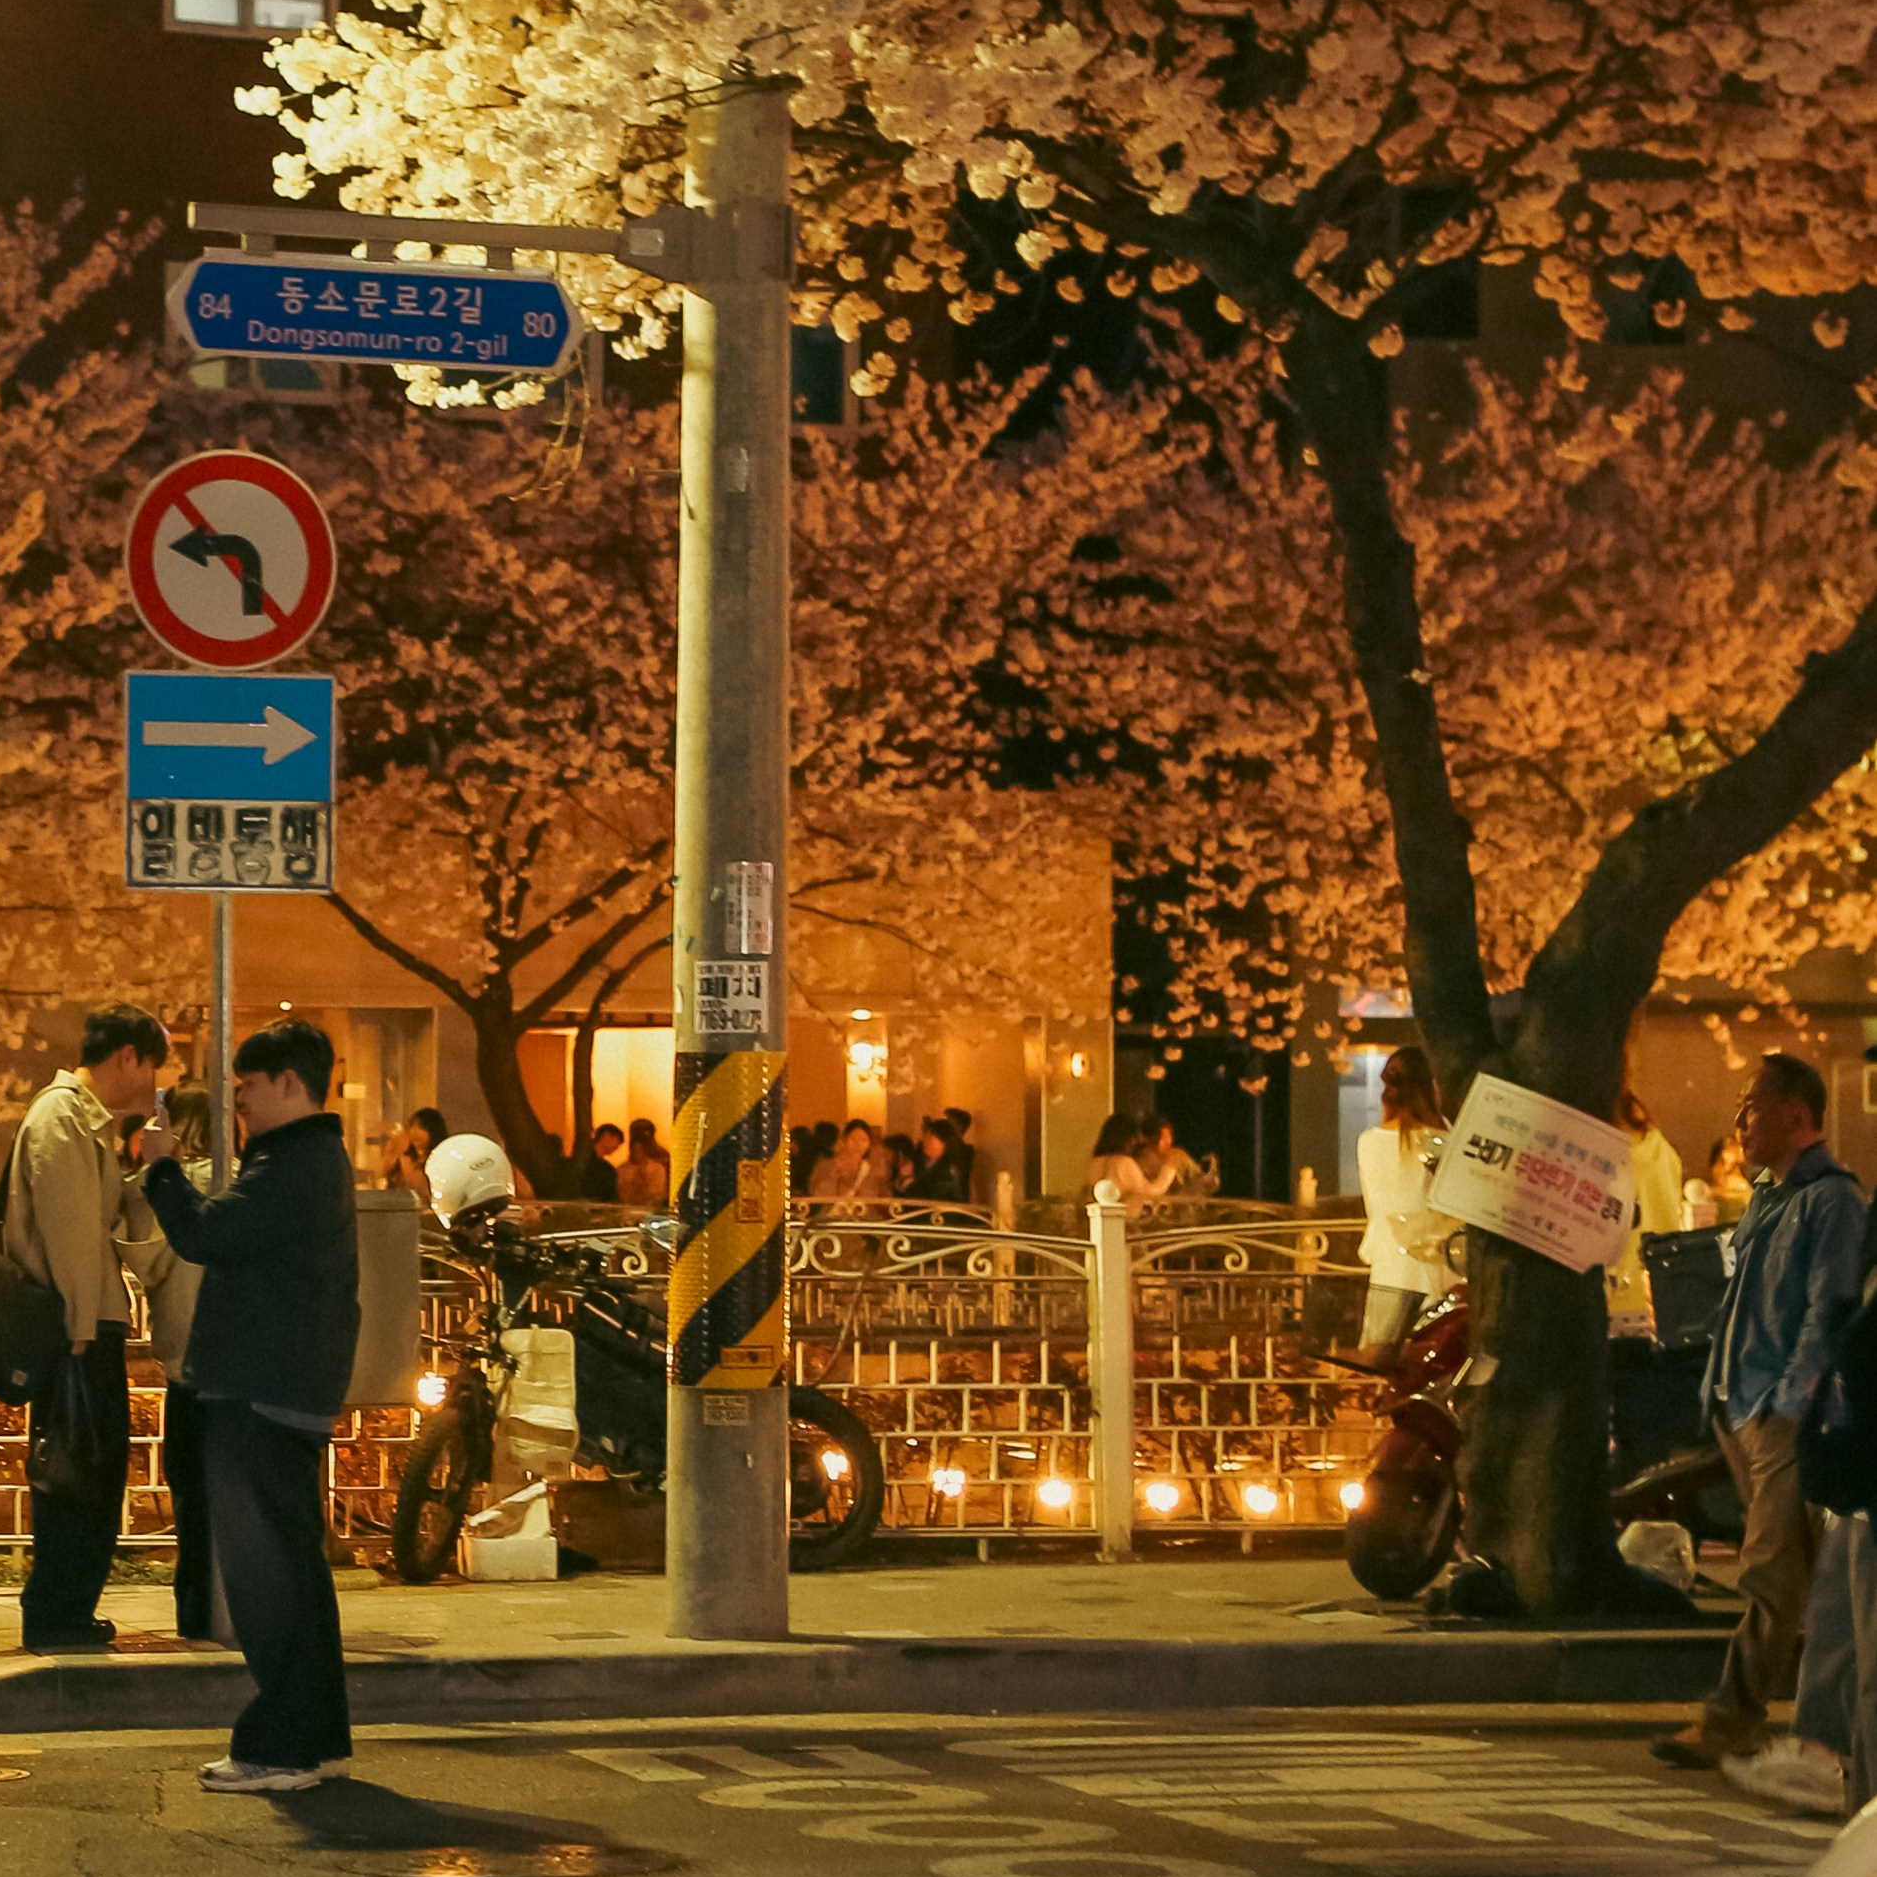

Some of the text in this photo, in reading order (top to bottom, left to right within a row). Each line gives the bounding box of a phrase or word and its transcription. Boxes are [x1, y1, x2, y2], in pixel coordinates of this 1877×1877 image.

[197, 292, 233, 320] 84
[275, 276, 484, 325] 동소문로2길
[247, 320, 509, 361] Dongsomun-ro 2-gil
[522, 311, 557, 340] 80
[140, 803, 319, 885] 일방통행
[1463, 1133, 1515, 1171] 쓰레기
